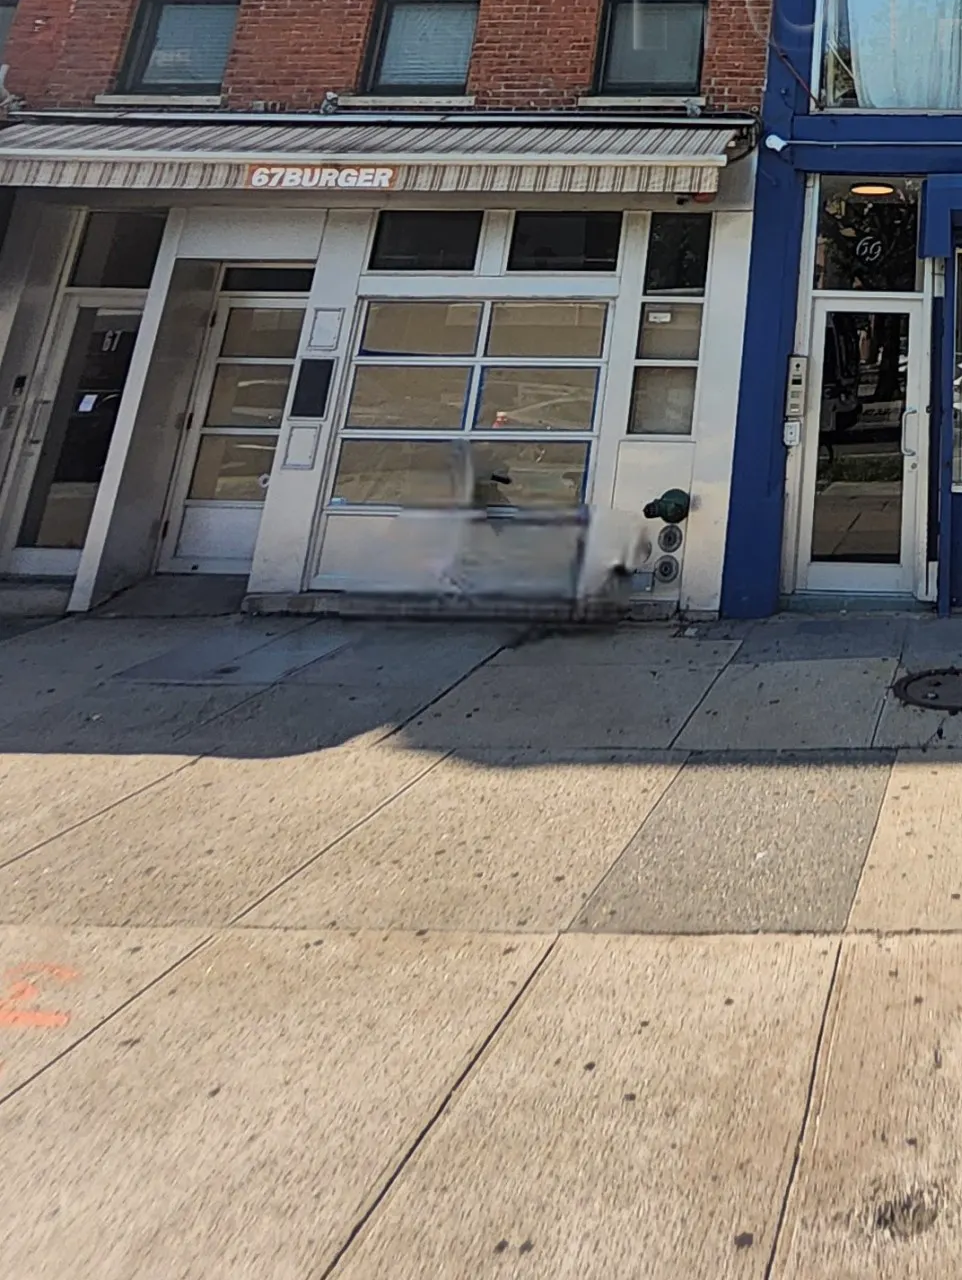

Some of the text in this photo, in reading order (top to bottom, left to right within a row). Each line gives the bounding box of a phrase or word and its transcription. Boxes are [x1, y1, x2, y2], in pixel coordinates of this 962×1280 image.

[251, 167, 393, 188] 67BURGER
[855, 236, 882, 262] 69
[102, 329, 123, 352] 67
